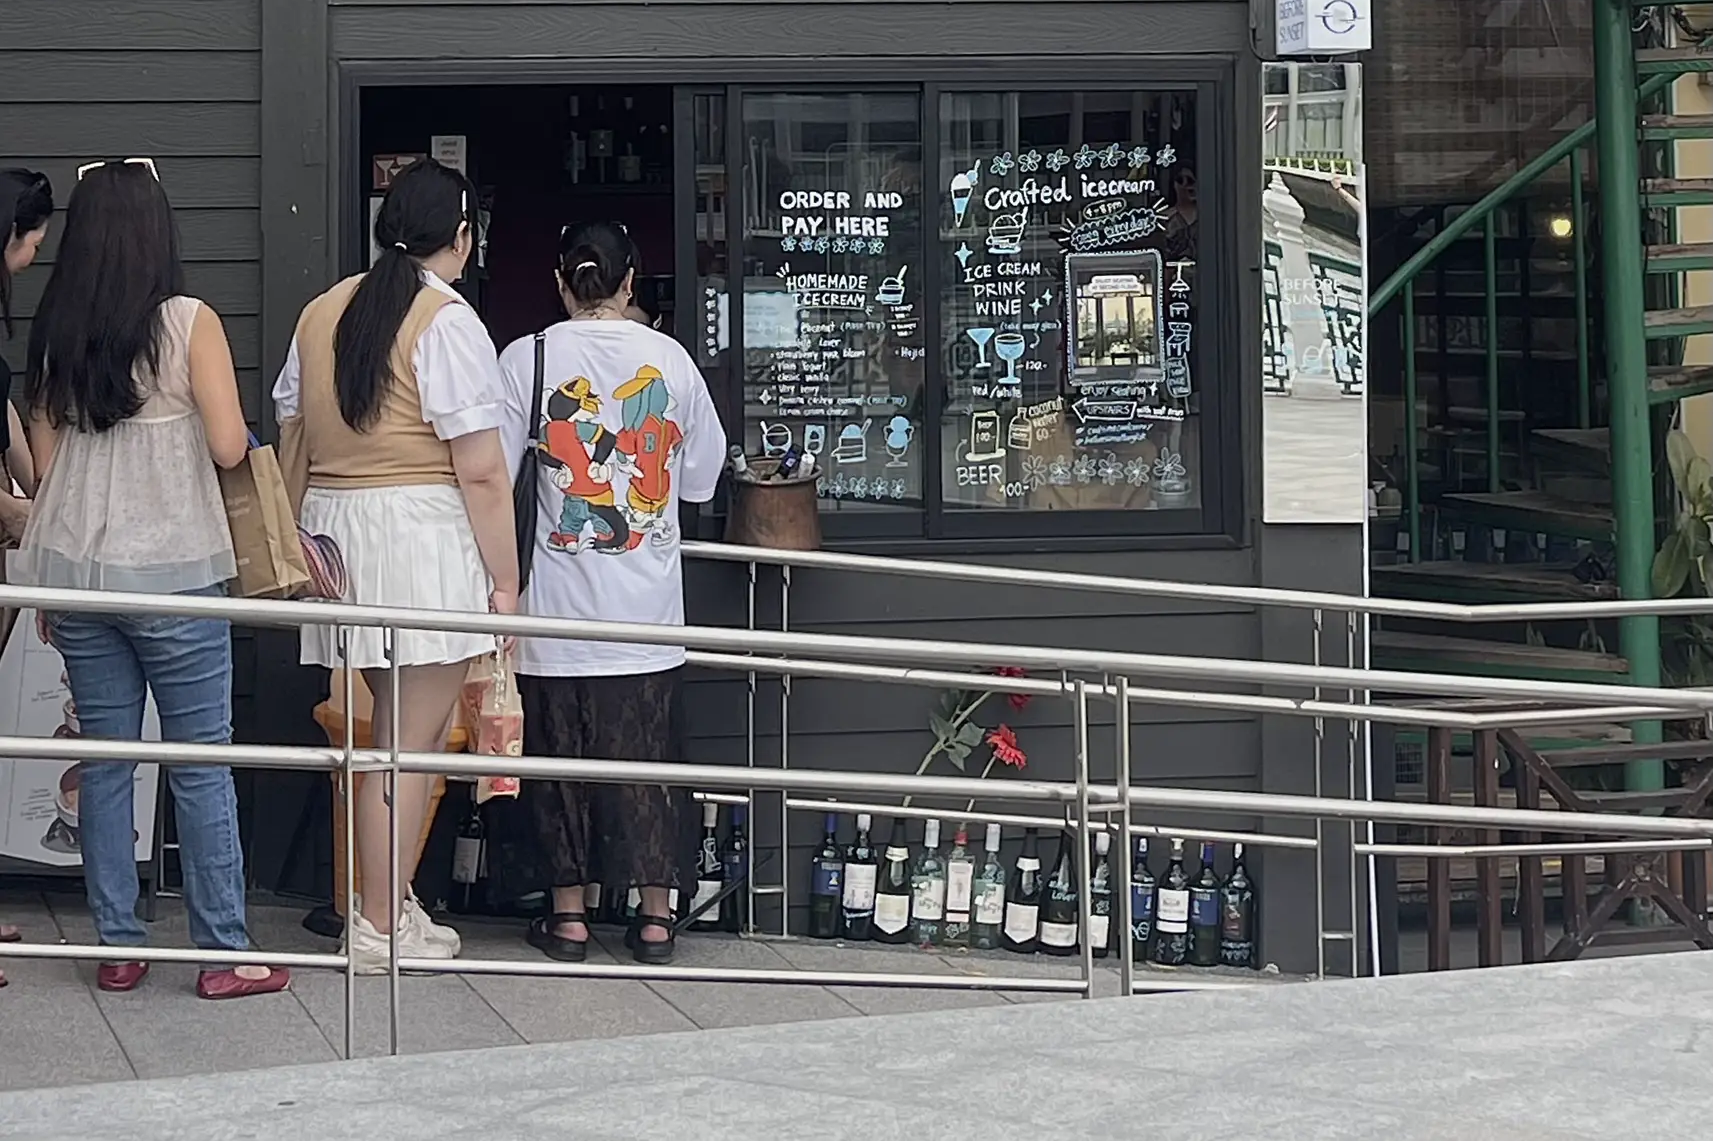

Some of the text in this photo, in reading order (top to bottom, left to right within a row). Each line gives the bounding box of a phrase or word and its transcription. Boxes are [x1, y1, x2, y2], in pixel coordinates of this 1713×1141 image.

[779, 191, 903, 210] ORDER AND
[984, 176, 1071, 210] Crafted
[781, 216, 889, 237] PAY HERE
[963, 260, 1041, 283] ICE CREAM
[786, 273, 868, 293] HOMEMADE
[973, 281, 1026, 298] DRINK
[975, 299, 1021, 316] WINE
[1086, 404, 1130, 415] UPSTAIRS
[642, 432, 657, 454] B
[956, 463, 1002, 487] BEER
